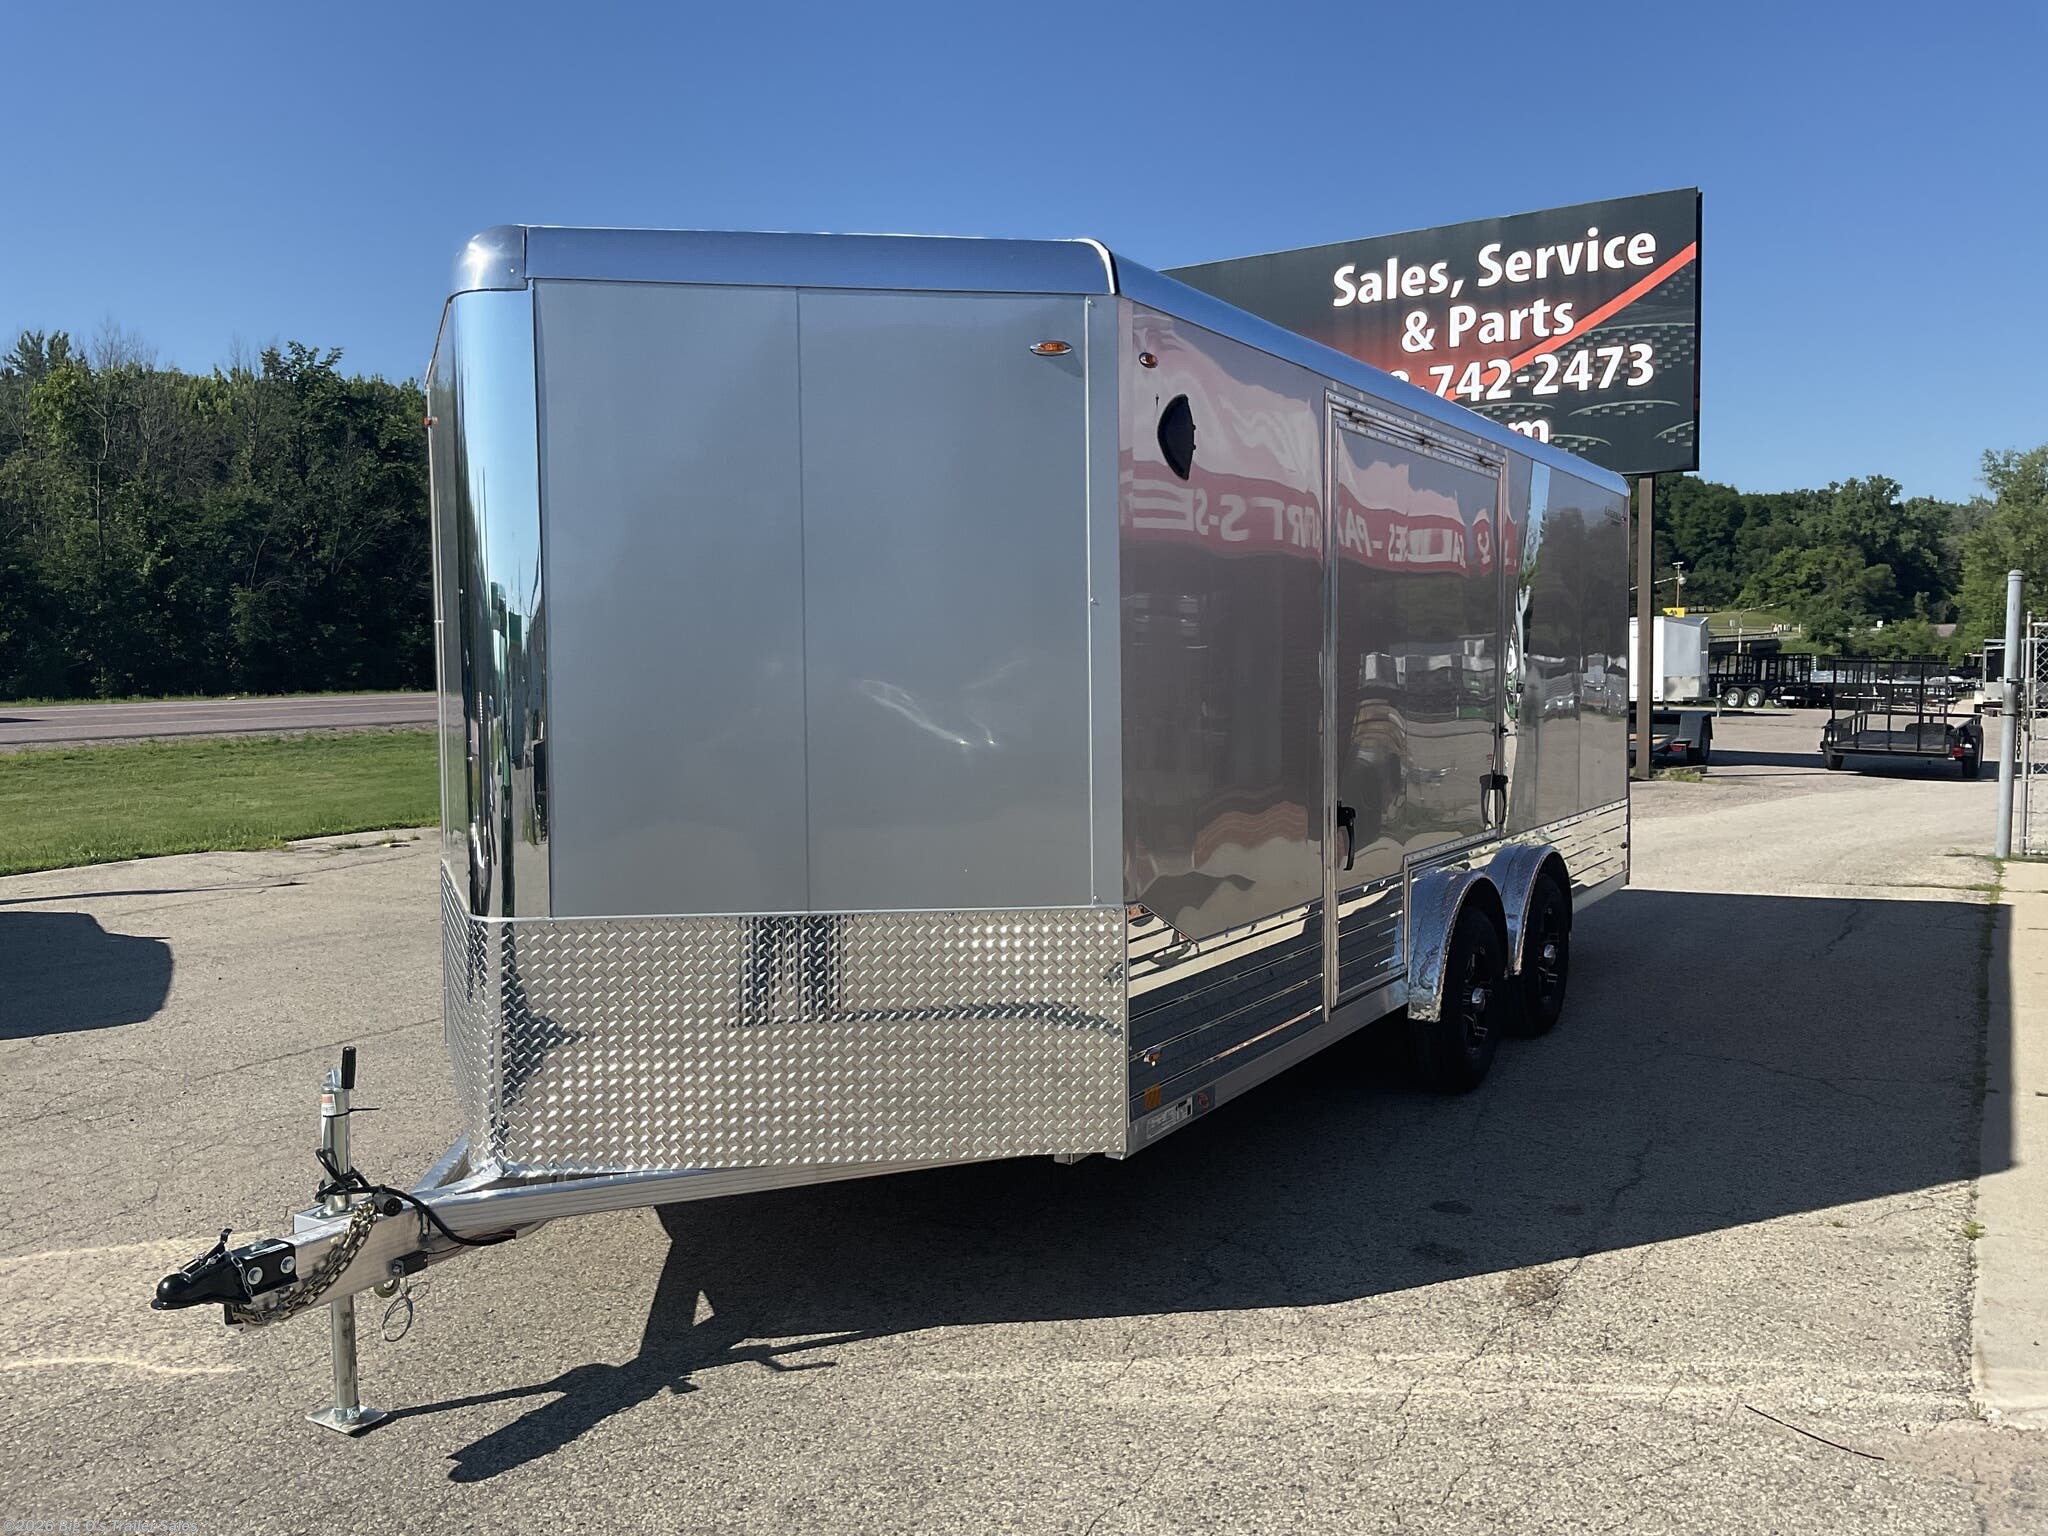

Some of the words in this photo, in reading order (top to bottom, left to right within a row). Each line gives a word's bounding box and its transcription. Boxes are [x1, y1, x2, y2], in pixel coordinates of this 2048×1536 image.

[1332, 256, 1464, 308] Sales,
[1477, 226, 1657, 287] Service
[1401, 310, 1436, 353] &
[1449, 298, 1575, 349] Parts
[1389, 343, 1654, 402] 742-2473
